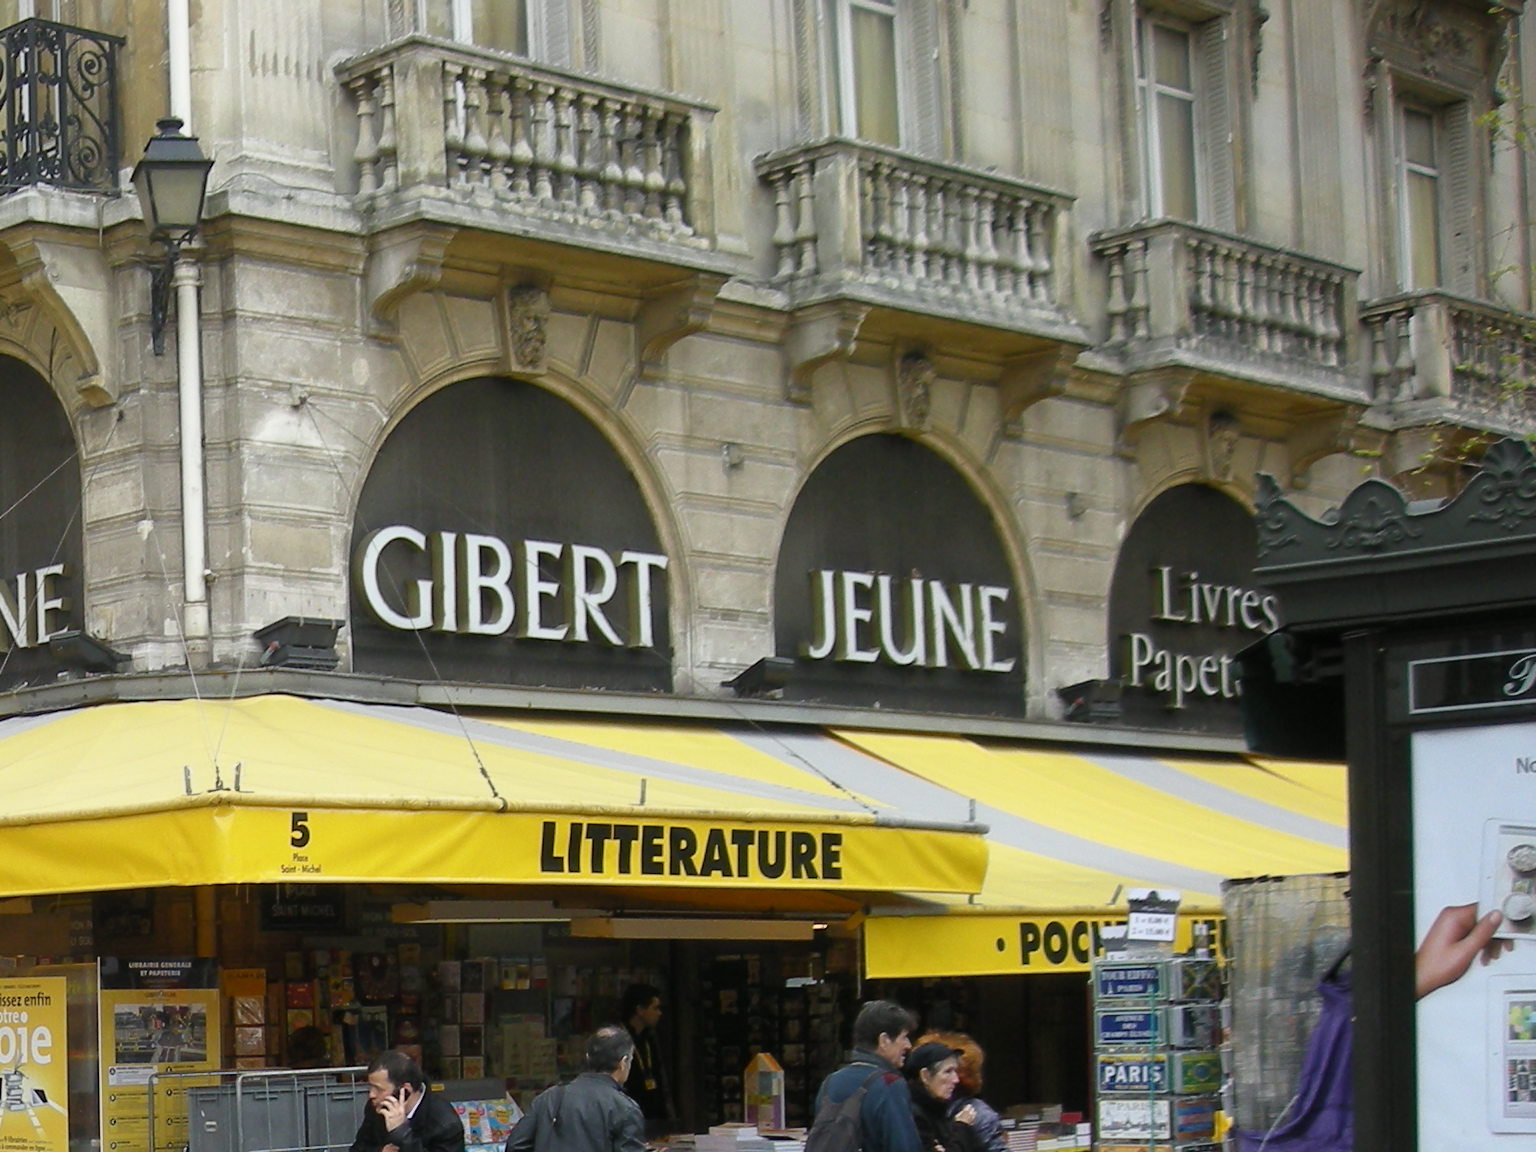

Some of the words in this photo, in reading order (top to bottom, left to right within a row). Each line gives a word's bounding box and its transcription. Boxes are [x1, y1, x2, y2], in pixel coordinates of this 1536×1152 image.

[362, 525, 668, 648] GIBERT
[1159, 566, 1280, 635] Livres
[807, 569, 1015, 673] JEUNE
[1130, 633, 1241, 708] Papet
[290, 812, 309, 848] 5
[540, 821, 844, 881] LITTERATURE
[281, 864, 296, 873] Saint
[301, 864, 321, 873] Michel
[293, 853, 309, 862] Place
[1020, 920, 1128, 965] POC
[24, 992, 52, 1007] enfin
[1104, 1065, 1162, 1083] PARIS
